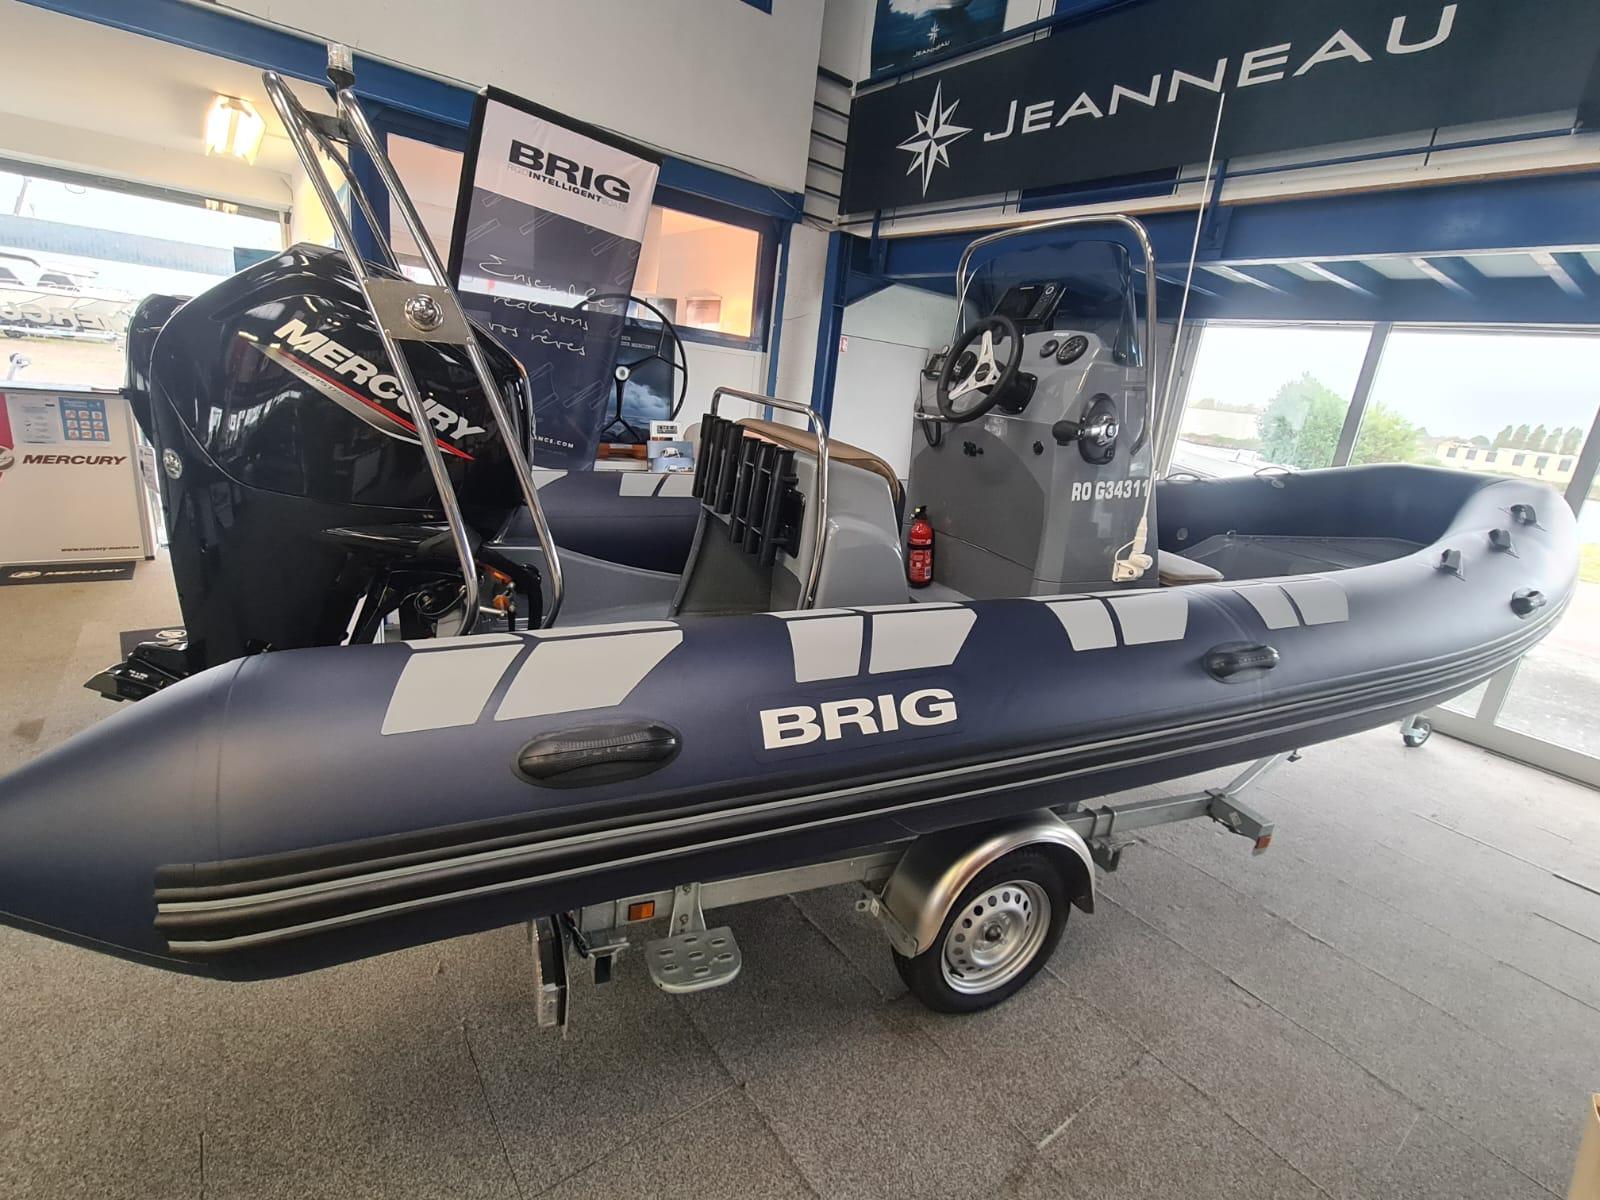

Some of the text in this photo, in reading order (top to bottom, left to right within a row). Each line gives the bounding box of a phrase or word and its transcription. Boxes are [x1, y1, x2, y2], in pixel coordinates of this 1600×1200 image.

[983, 4, 1458, 142] JEANNEAU
[508, 139, 631, 203] BRIG
[22, 454, 127, 465] MERCURY
[1071, 481, 1092, 501] RO
[760, 688, 958, 750] BRIG
